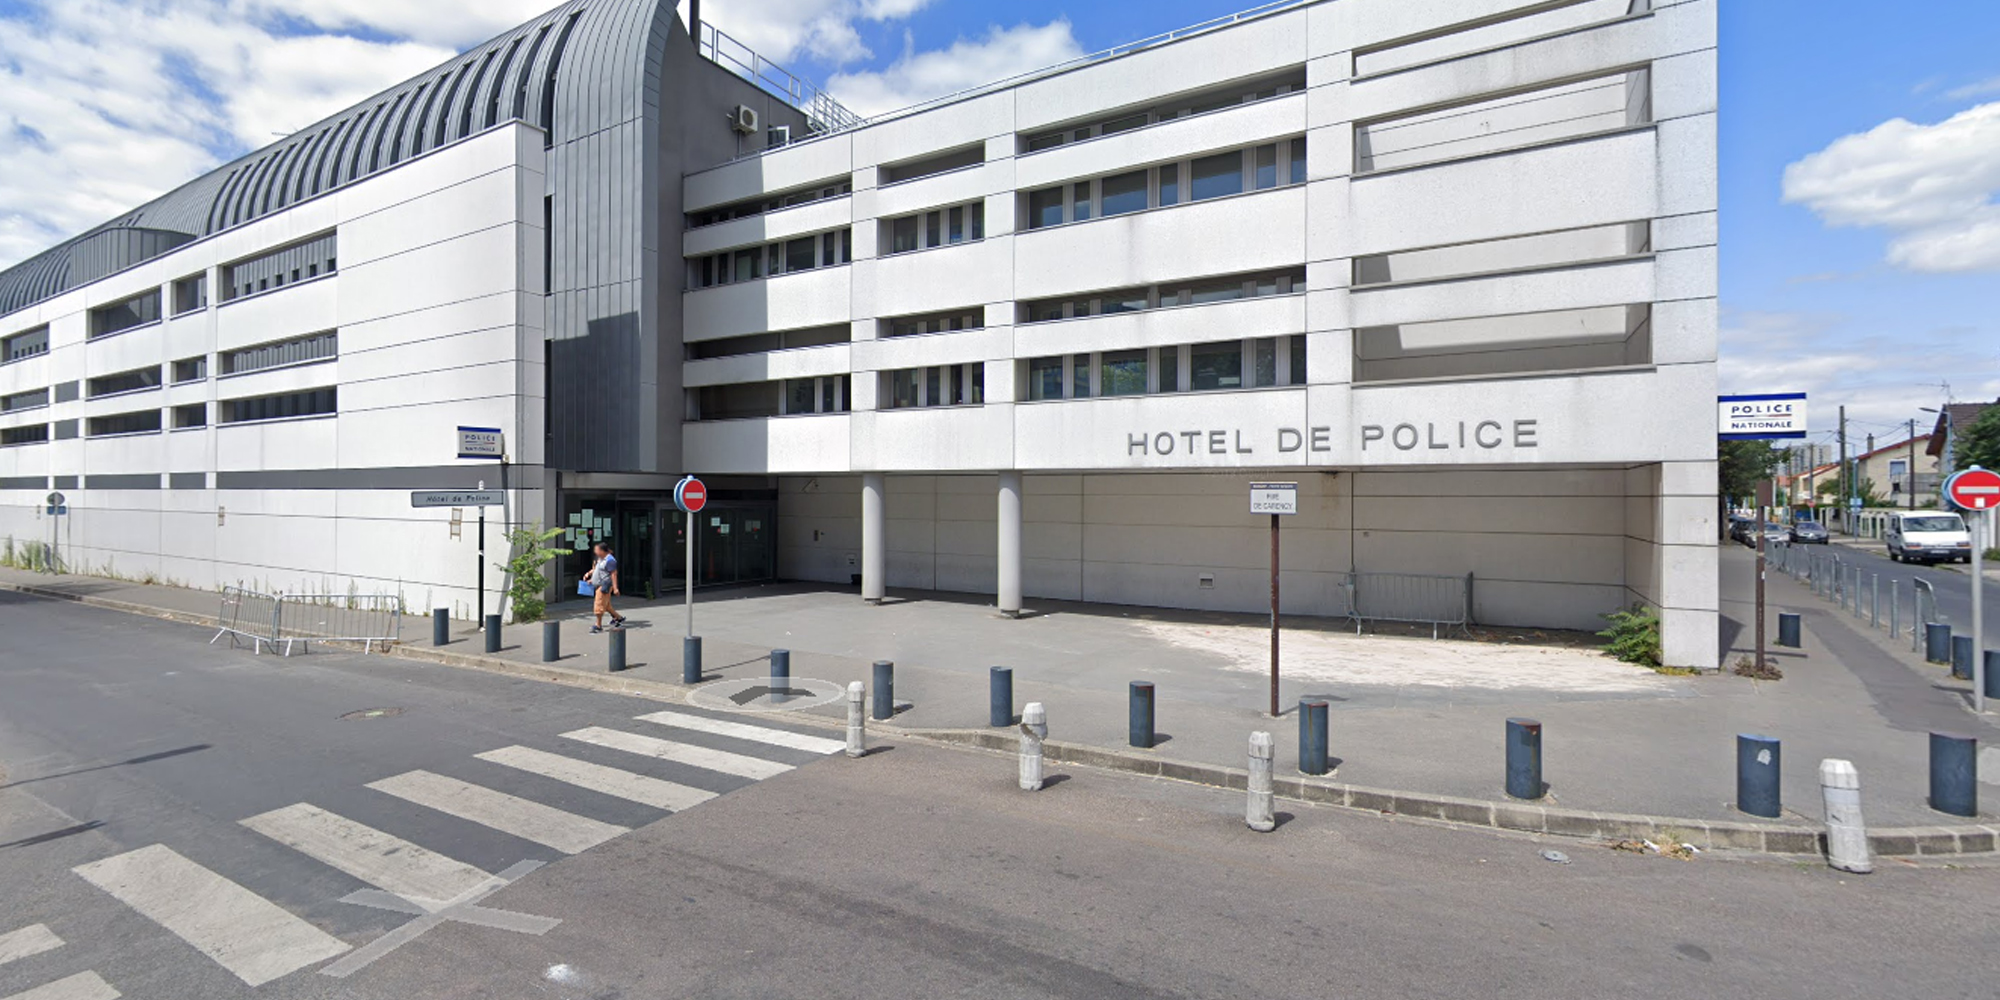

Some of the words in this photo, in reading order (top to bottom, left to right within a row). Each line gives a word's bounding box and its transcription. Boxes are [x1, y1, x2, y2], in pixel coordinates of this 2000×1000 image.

[1731, 404, 1792, 413] POLICE
[1731, 421, 1792, 429] NATIONALE
[465, 434, 496, 442] POLICE
[1127, 430, 1253, 456] HOTEL
[1278, 426, 1331, 453] DE
[1361, 419, 1538, 451] POLICE
